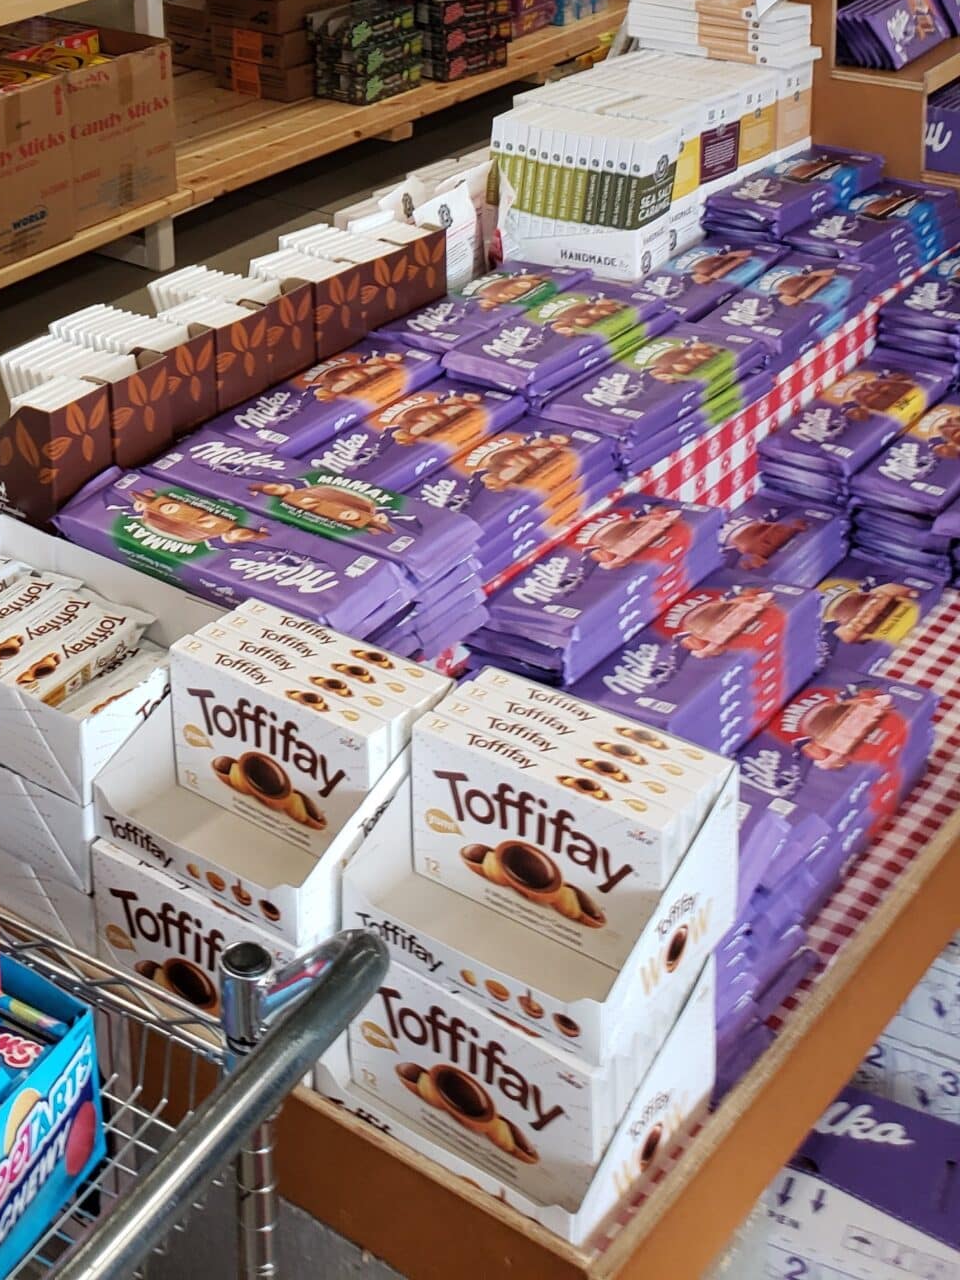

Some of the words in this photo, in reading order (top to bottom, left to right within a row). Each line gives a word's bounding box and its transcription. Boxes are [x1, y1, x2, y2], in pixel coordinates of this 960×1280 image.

[70, 112, 121, 140] Candy
[127, 96, 169, 117] Sticks
[19, 130, 66, 159] Sticks
[639, 192, 656, 210] SEA
[560, 249, 617, 267] HANDMADE
[481, 323, 533, 359] Milka
[234, 391, 291, 431] Milka
[189, 441, 288, 472] Milka
[311, 431, 369, 473] Milka
[878, 441, 923, 482] Milka
[228, 556, 340, 594] Milka
[62, 613, 127, 658] Toffifay
[280, 615, 337, 645] Toffifay
[527, 688, 598, 721] Toffifay
[186, 687, 350, 798] Toffifay
[431, 718, 448, 731] 12
[356, 912, 445, 973] Toffifay
[377, 986, 568, 1131] Toffifay
[814, 1101, 917, 1146] lka
